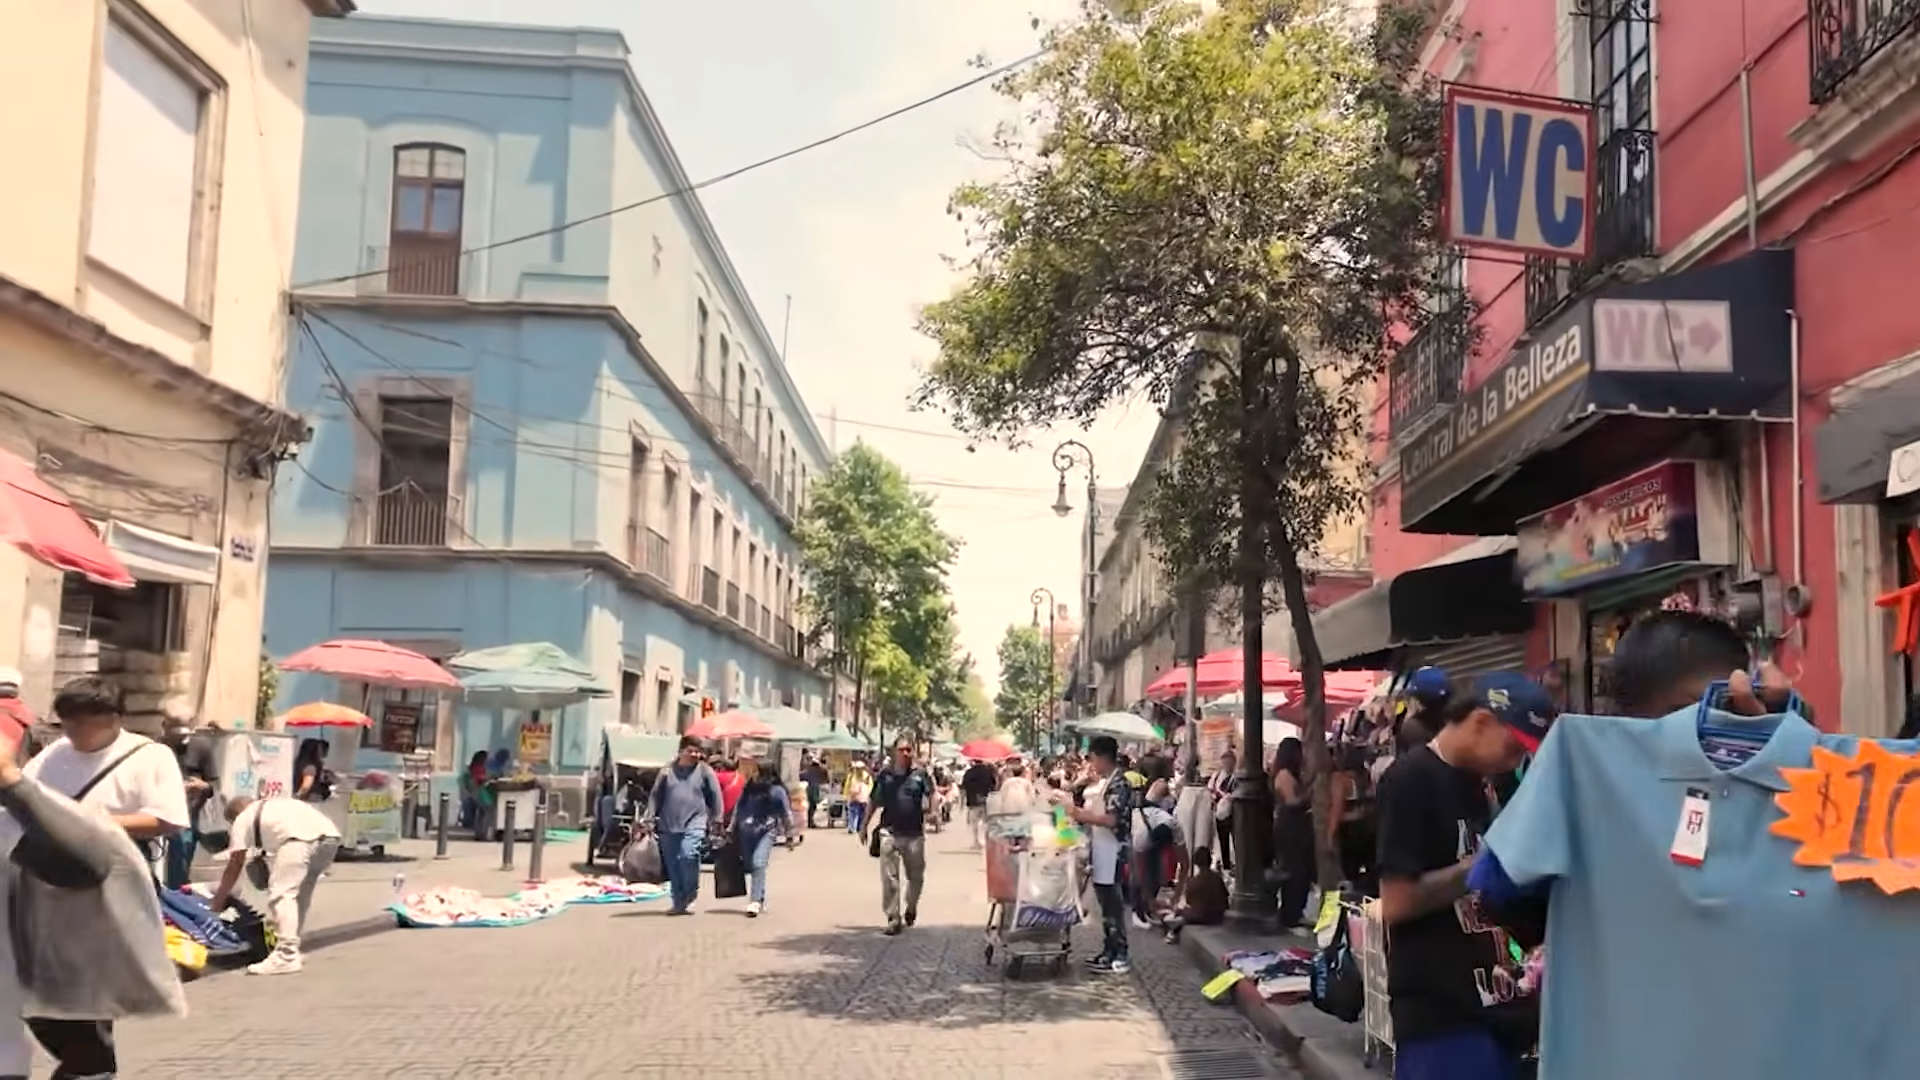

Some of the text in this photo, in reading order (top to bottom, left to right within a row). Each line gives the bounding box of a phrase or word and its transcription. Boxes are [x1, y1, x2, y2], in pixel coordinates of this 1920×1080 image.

[1457, 103, 1585, 248] WC
[1457, 402, 1478, 443] de
[1481, 386, 1499, 426] la
[1504, 324, 1582, 411] Belleza
[1604, 306, 1686, 363] WC
